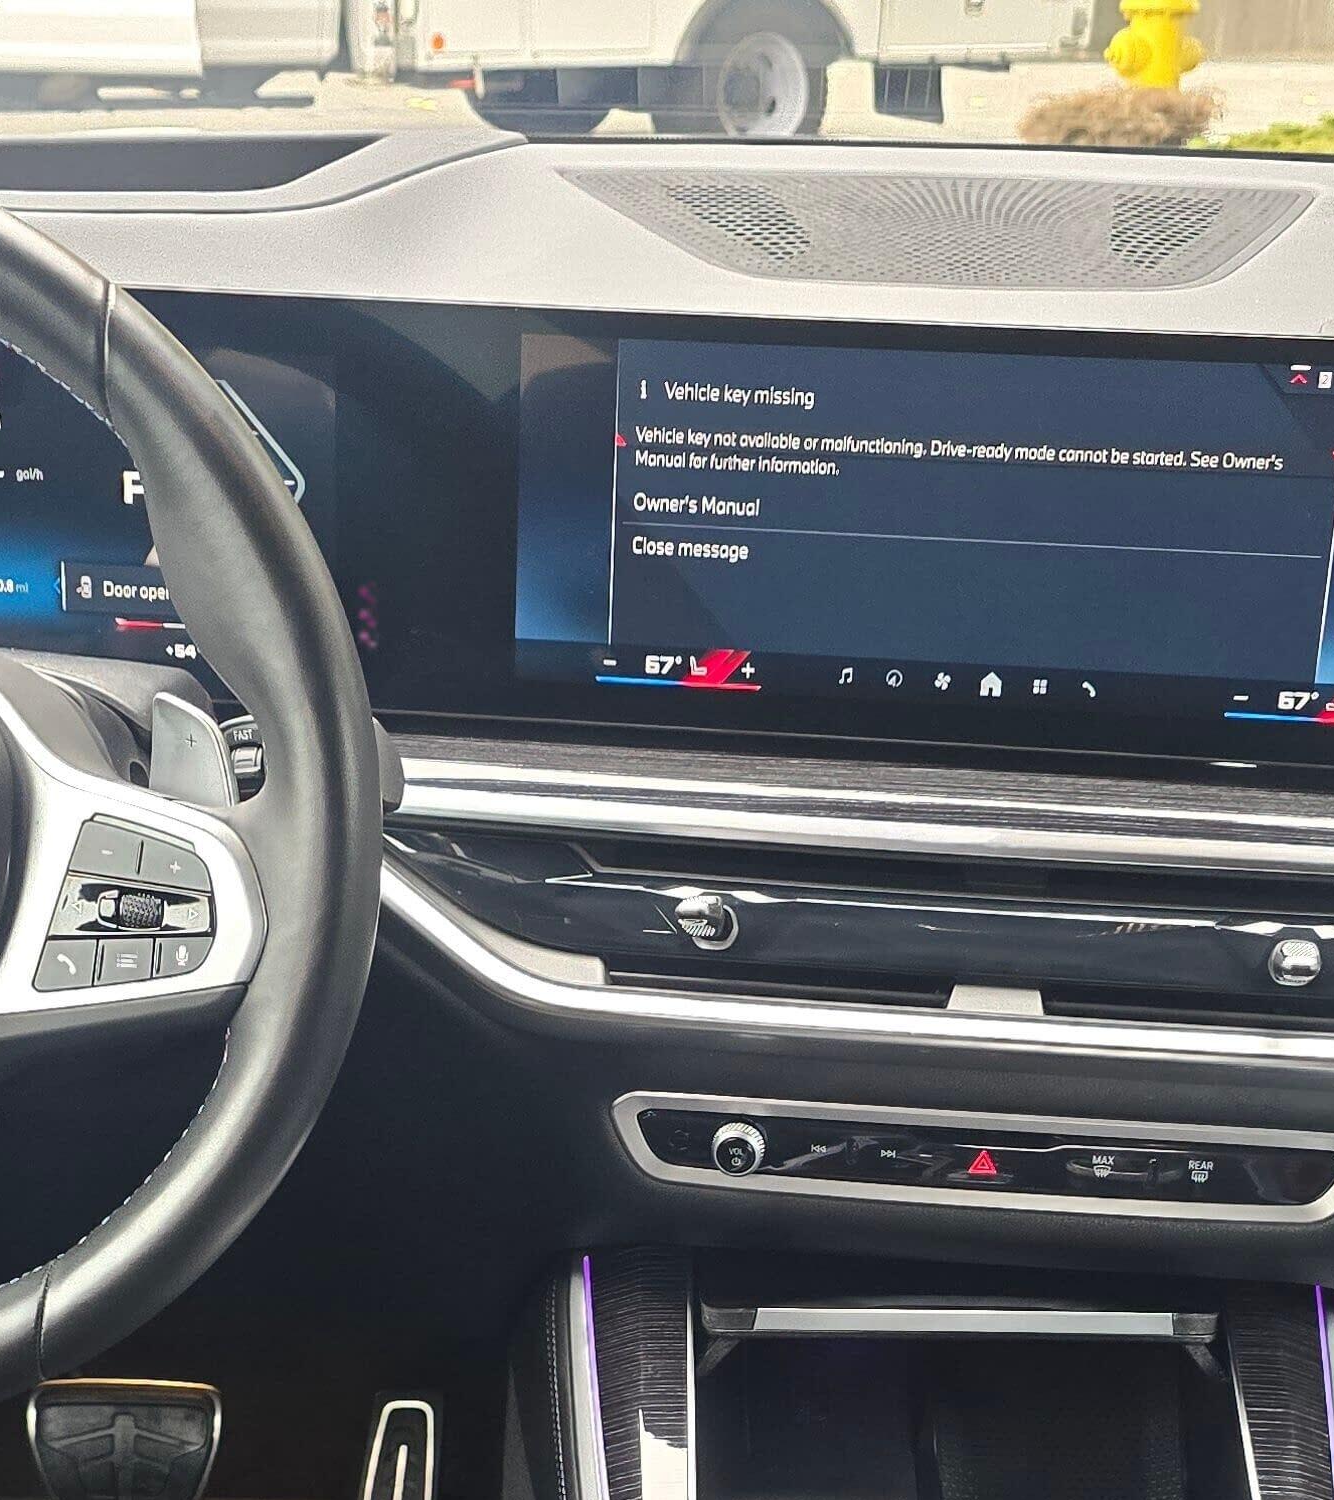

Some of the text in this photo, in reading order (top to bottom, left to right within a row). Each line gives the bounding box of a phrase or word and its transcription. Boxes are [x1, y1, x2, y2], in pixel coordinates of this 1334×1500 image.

[664, 381, 815, 410] Vehicle key missing
[635, 426, 1284, 471] Vehicle key not available or malfunctioning. Drive-ready mode cannot be started. See Owner's
[635, 450, 840, 476] Manual for further information.
[633, 492, 760, 517] Owner's Manual
[632, 536, 749, 563] Close message
[103, 580, 138, 598] Door
[233, 728, 253, 741] FAST
[1092, 1155, 1116, 1166] MAX
[1188, 1160, 1214, 1171] REAR
